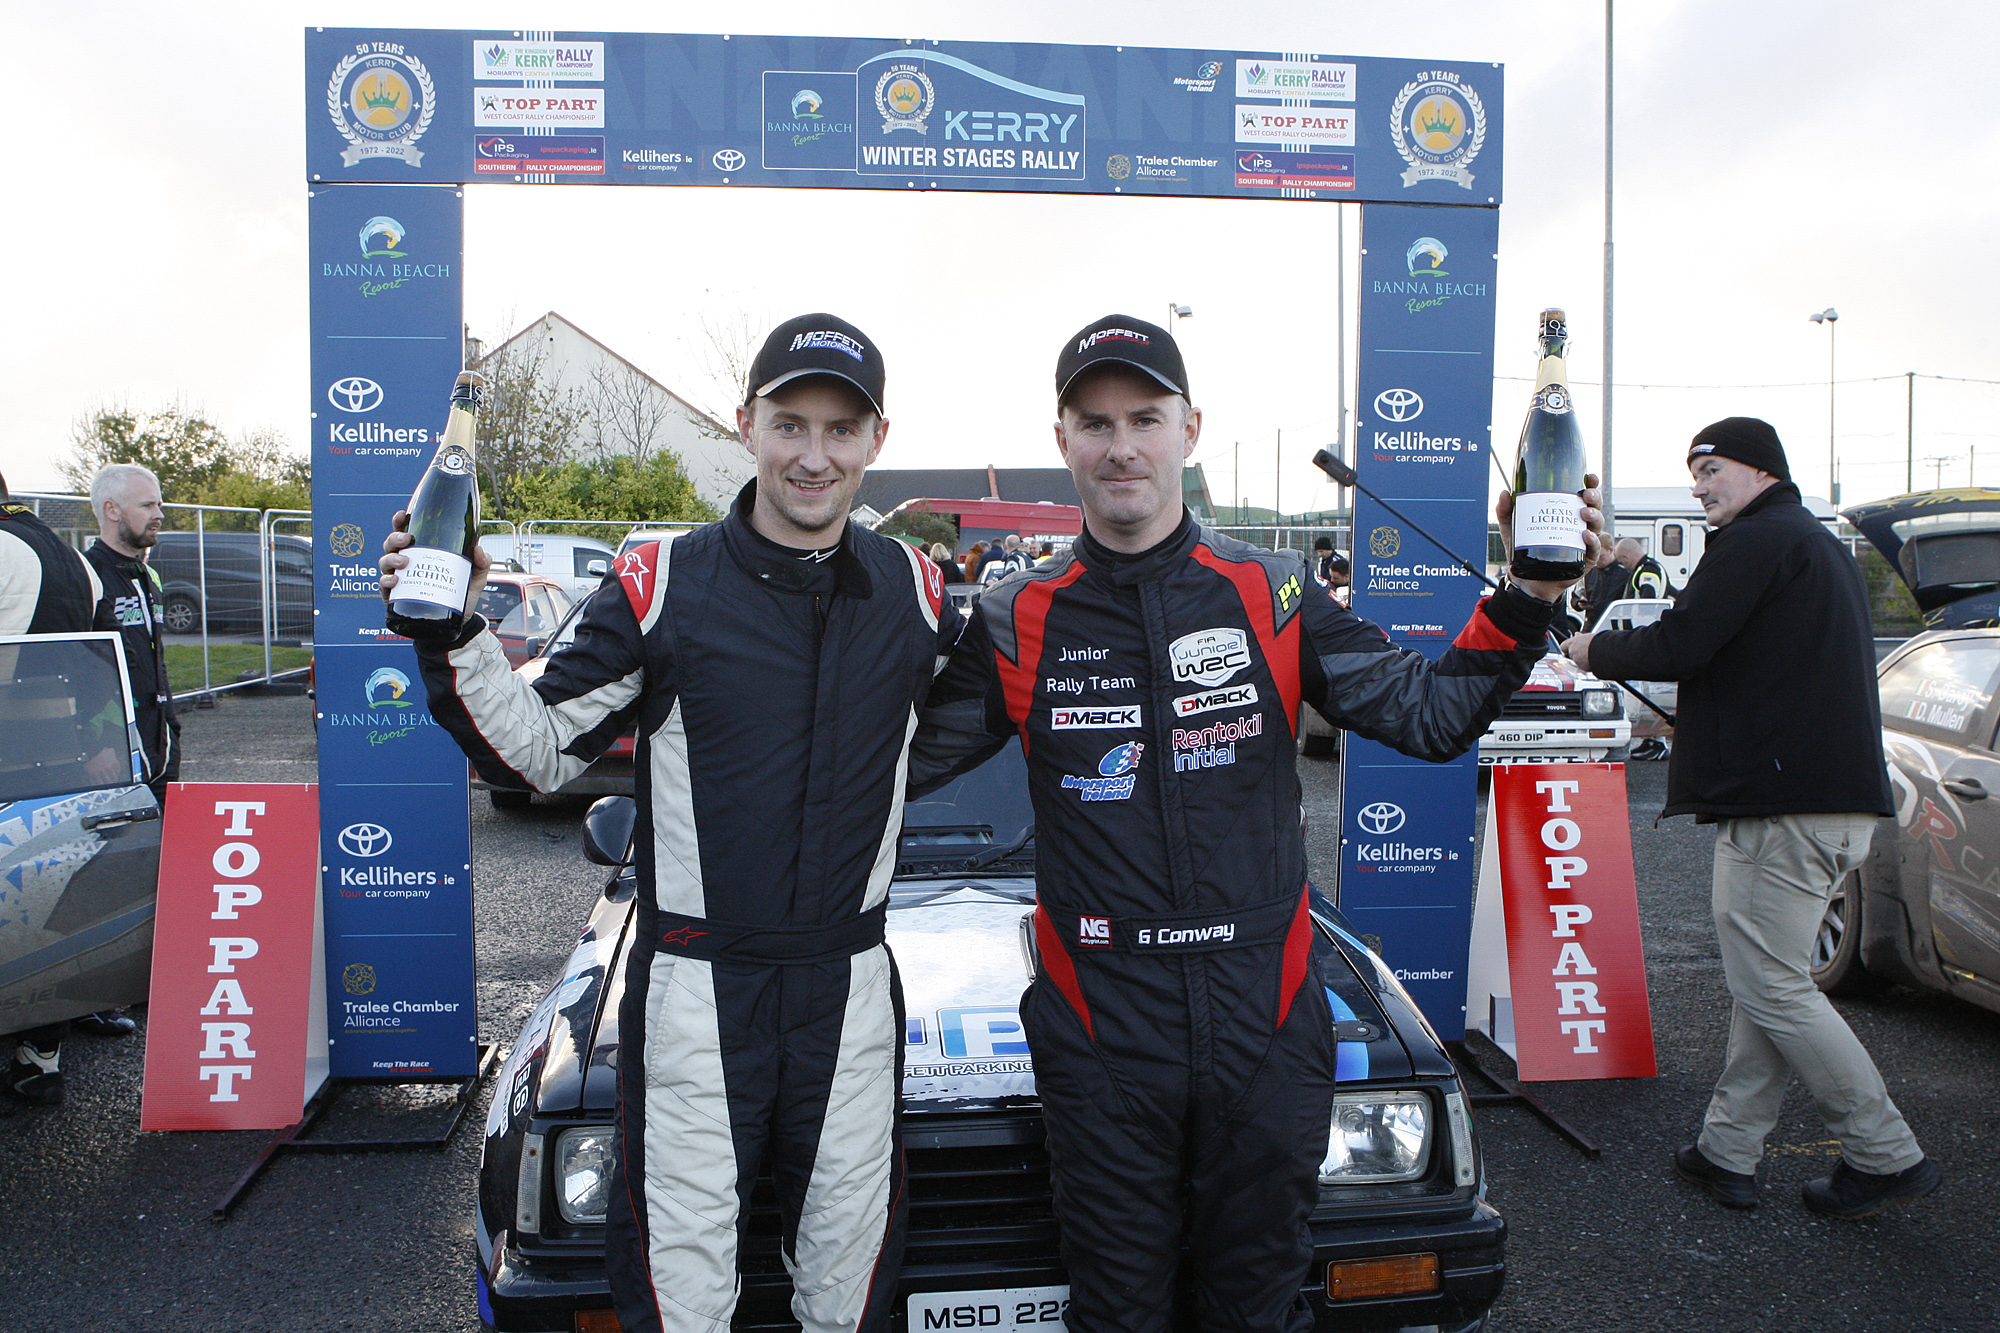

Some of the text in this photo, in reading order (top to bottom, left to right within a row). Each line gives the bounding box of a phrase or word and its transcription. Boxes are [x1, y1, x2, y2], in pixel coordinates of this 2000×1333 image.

[356, 42, 405, 56] 50 YEARS
[365, 58, 398, 68] KERRY
[516, 49, 593, 68] KERRY RALLY
[1173, 78, 1216, 86] Motorsport
[1274, 70, 1346, 87] KERRY RALLY
[1416, 70, 1460, 84] 50 YEARS
[1425, 86, 1453, 96] KERRY
[502, 99, 597, 110] TOP PART
[767, 122, 852, 133] BANNA BEACH
[945, 110, 1078, 144] KERRY
[1262, 116, 1348, 129] TOP PART
[352, 121, 412, 140] MOTOR CLUB
[791, 132, 825, 146] Resort
[360, 146, 405, 155] 1972 2022
[494, 144, 514, 152] IPS
[1412, 144, 1465, 163] MOTOR CLUB
[622, 150, 692, 164] Kellihers.ie
[862, 146, 1080, 170] WINTER STAGES RALLY
[1136, 156, 1218, 167] Tralee Chamber
[1254, 160, 1272, 168] IPS
[1136, 166, 1176, 176] Alliance
[1441, 169, 1458, 177] 2022
[323, 263, 450, 278] BANNA BEACH
[359, 278, 410, 298] Resort
[1374, 280, 1486, 296] BANNA BEACH
[1405, 296, 1450, 314] Resort
[788, 331, 864, 353] MOFFETT
[1078, 328, 1149, 354] MOFFETT
[810, 340, 862, 360] MOTORSPORT
[1374, 432, 1478, 452] Kellihers.ie
[328, 446, 422, 458] Your car company
[1373, 453, 1394, 462] Your
[1412, 455, 1455, 464] company
[1538, 508, 1574, 516] ALEXIS
[1531, 515, 1578, 526] LICHINE
[330, 564, 377, 577] Tralee
[414, 563, 450, 575] ALEXIS
[1368, 564, 1410, 576] Tralee
[406, 570, 456, 586] LICHINE
[1368, 578, 1420, 590] Alliance
[330, 579, 380, 592] Allianc
[358, 628, 380, 636] Keep
[1197, 636, 1216, 645] FIA
[1058, 646, 1110, 662] Junior
[1178, 640, 1240, 660] JUNIOR
[1176, 651, 1247, 679] WRC
[1046, 676, 1136, 696] Rally Team
[331, 713, 440, 726] BANNA BEAC
[1927, 704, 1965, 731] Mullen
[366, 726, 416, 747] Resort
[1172, 714, 1262, 750] Rentokil
[1498, 734, 1520, 742] 460
[1174, 743, 1236, 772] Initial
[1061, 774, 1136, 790] Motorsport
[1080, 786, 1132, 802] Ireland
[1358, 843, 1458, 862] Kellihers.ie
[340, 866, 455, 886] Kellihers.ie
[1356, 864, 1376, 872] Your
[1394, 864, 1436, 874] company
[340, 890, 430, 900] Your car company
[1536, 780, 1606, 1054] TOP PART
[1080, 918, 1110, 938] NG
[1138, 923, 1234, 944] G Conway
[199, 801, 266, 1103] TOP PART
[1394, 968, 1454, 981] Chamber
[343, 1000, 460, 1013] Tralee Chamber
[344, 1015, 400, 1028] Alliance
[372, 1061, 394, 1069] Keep
[924, 1304, 1000, 1330] MSD
